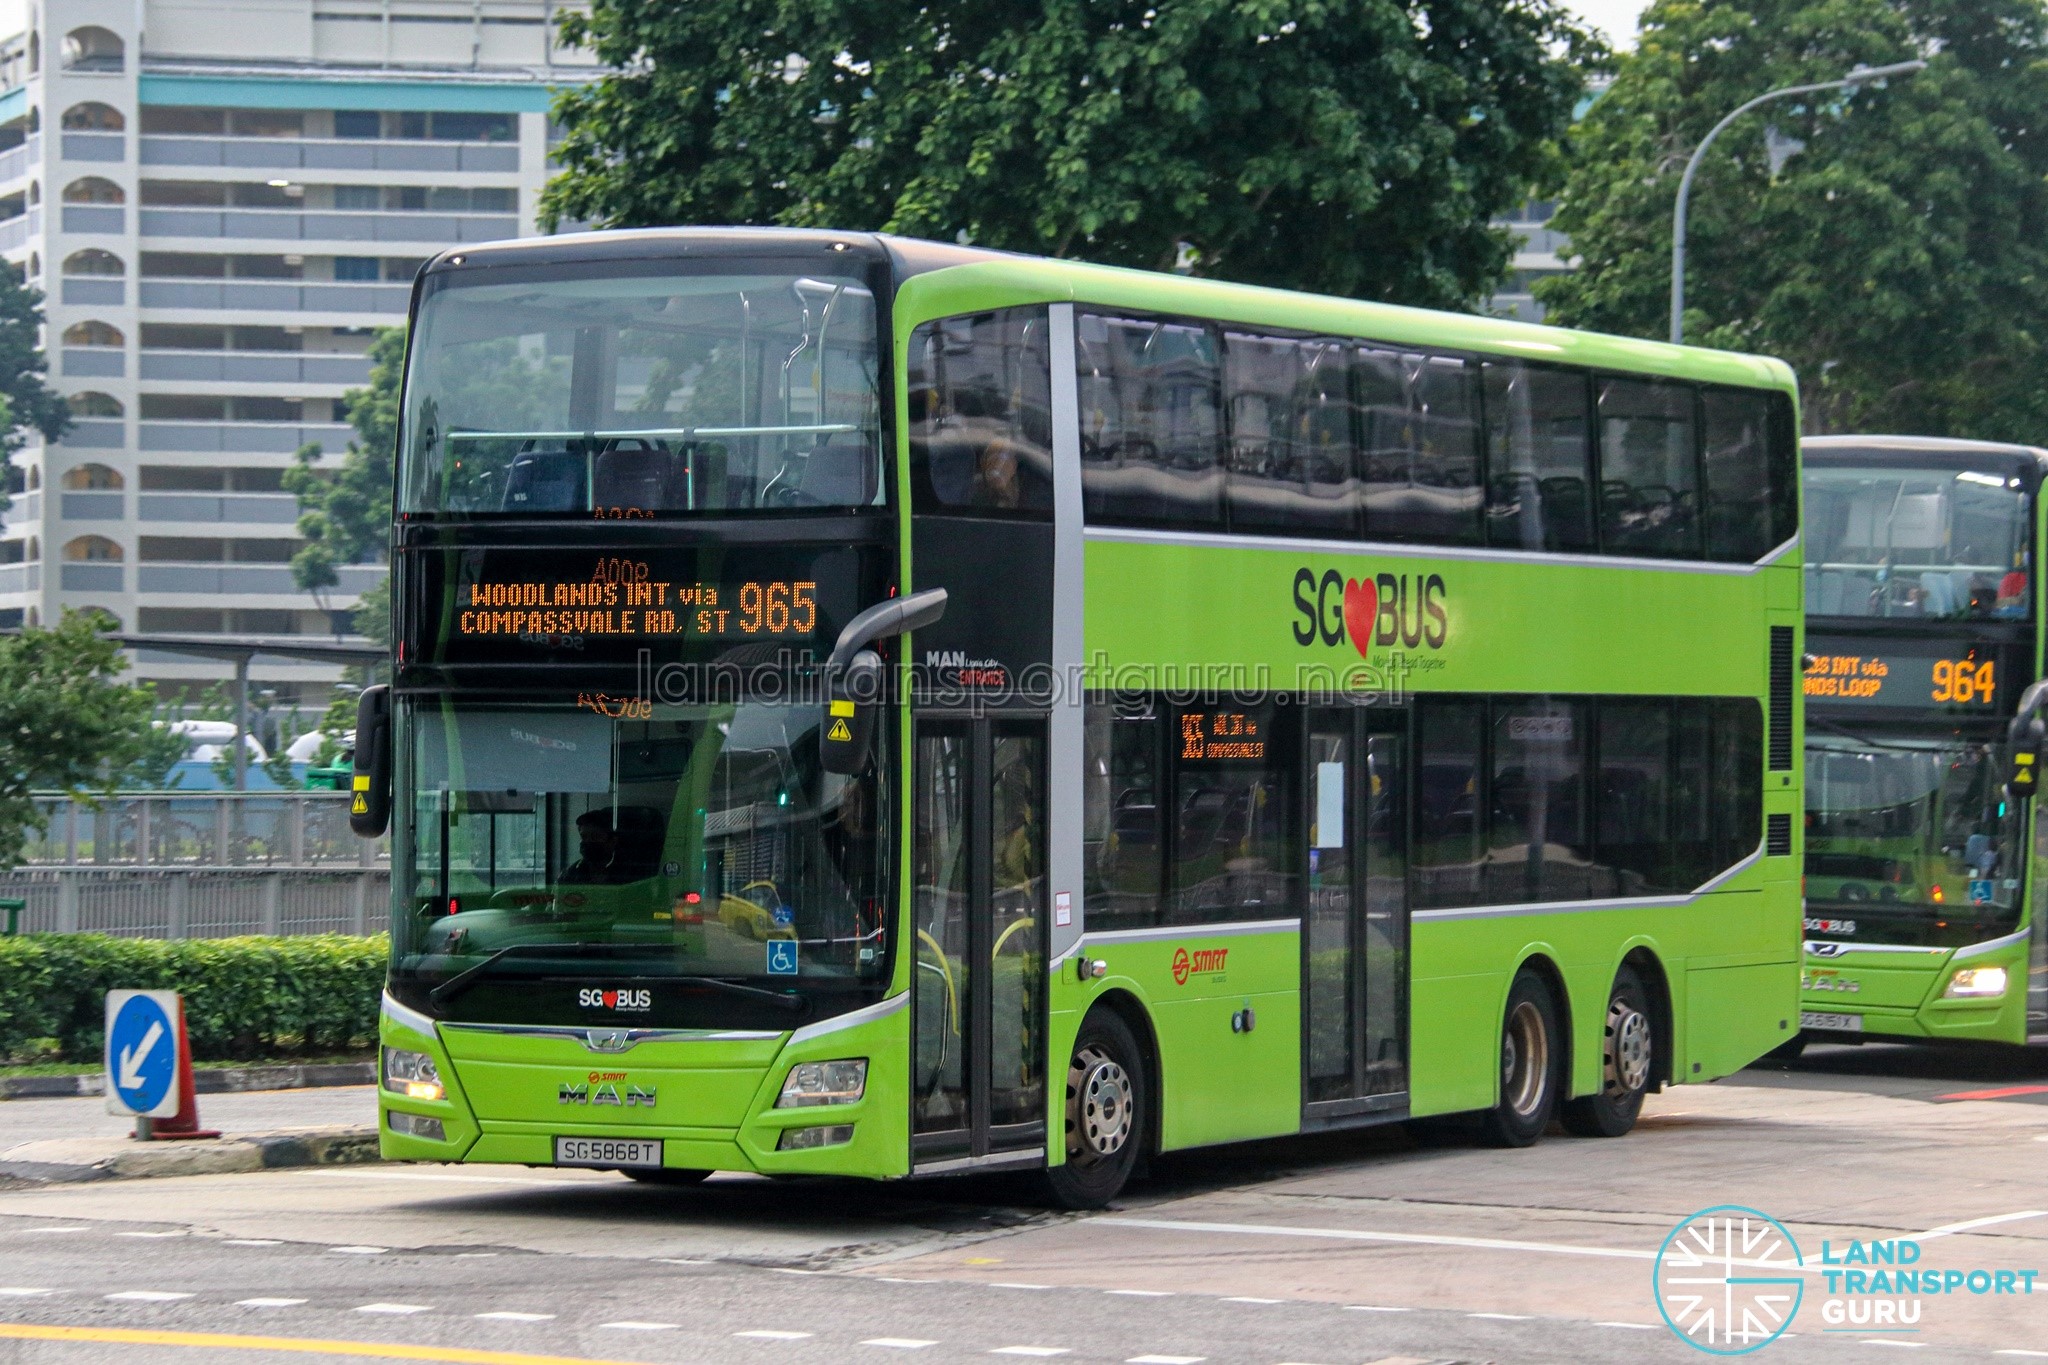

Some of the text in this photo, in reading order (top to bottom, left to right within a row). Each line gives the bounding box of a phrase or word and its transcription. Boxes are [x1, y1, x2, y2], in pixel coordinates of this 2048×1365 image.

[471, 582, 717, 606] WOODLANDS INT via
[739, 581, 816, 633] 965
[461, 610, 636, 634] COMPASSVALE
[697, 610, 730, 633] ST
[926, 650, 965, 668] MAN
[959, 669, 1005, 685] ENTRANCE
[1838, 678, 1882, 698] LOOP
[1931, 659, 1996, 704] 964
[1191, 948, 1228, 973] SMRT
[601, 1072, 627, 1081] SMRT
[559, 1083, 656, 1108] MAN
[564, 1141, 654, 1162] SG5868T
